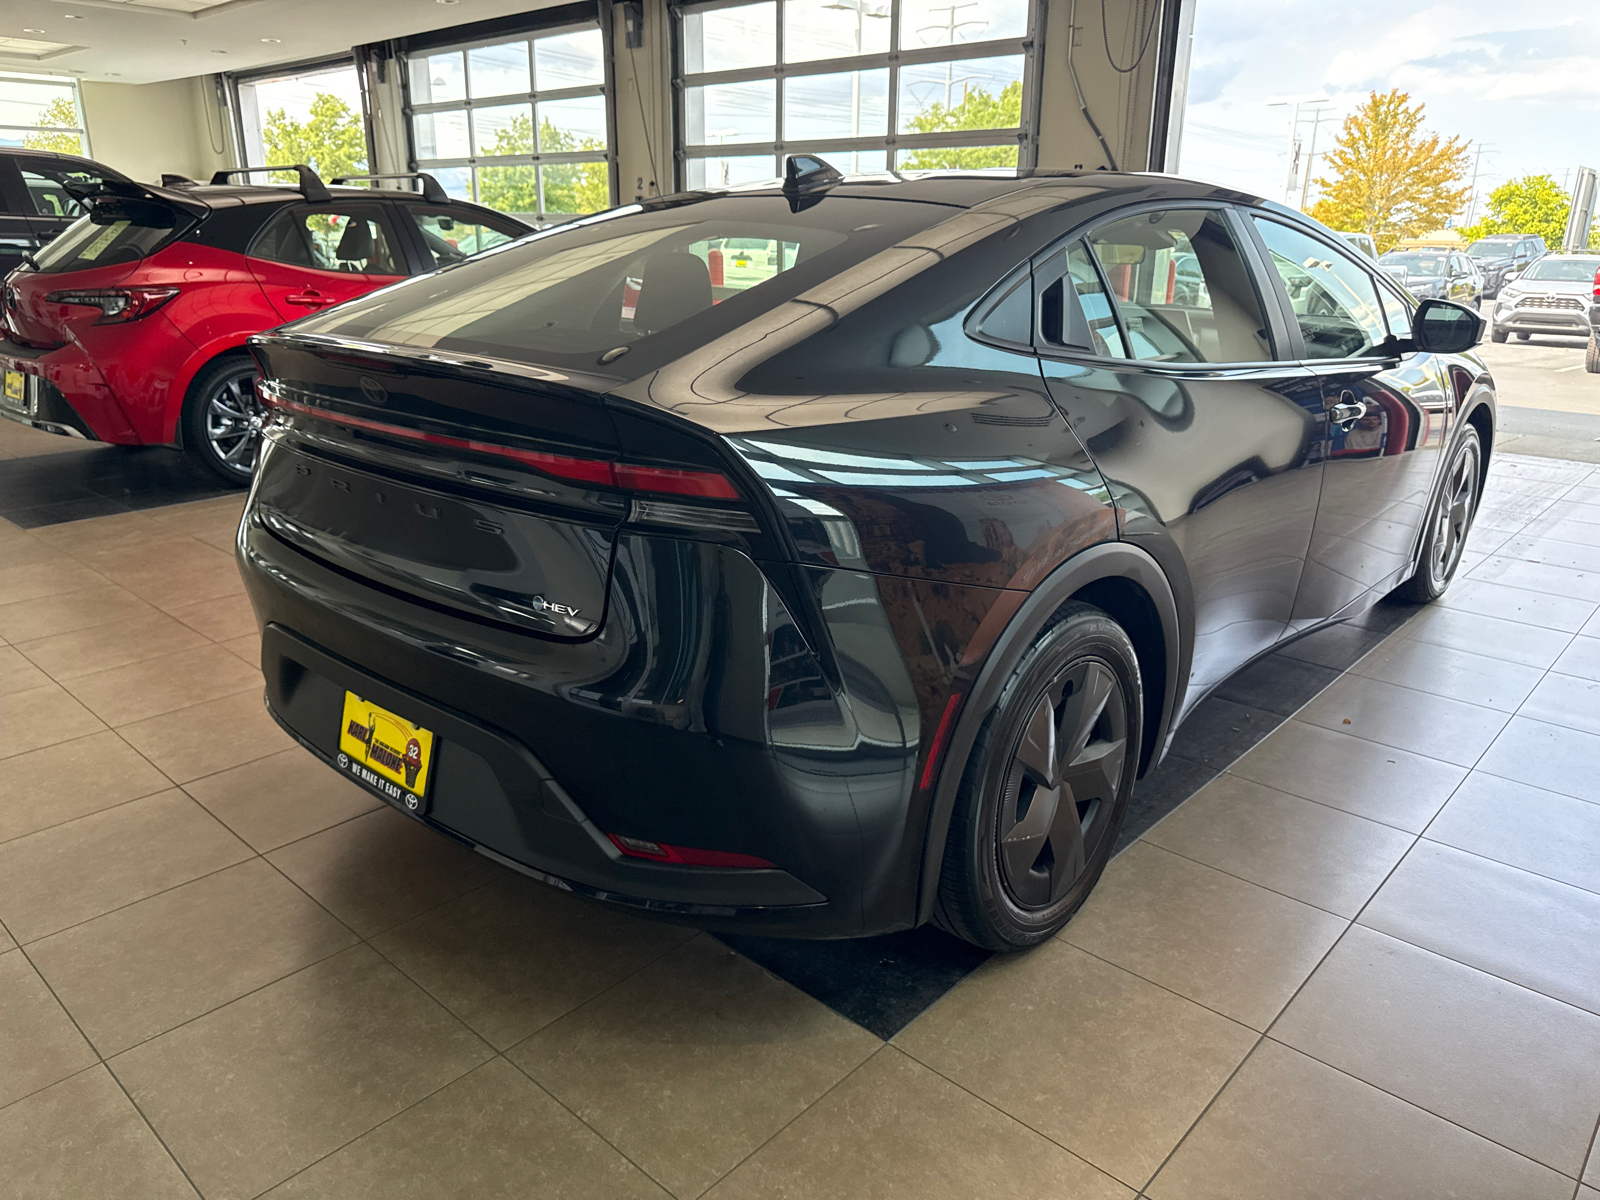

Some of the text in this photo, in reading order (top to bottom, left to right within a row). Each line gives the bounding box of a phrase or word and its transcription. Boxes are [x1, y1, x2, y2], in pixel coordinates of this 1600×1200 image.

[637, 177, 643, 190] 2
[296, 463, 503, 535] PRIUS
[347, 720, 369, 744] KARL
[370, 743, 402, 773] MALONE
[408, 744, 418, 760] 32
[351, 762, 401, 799] WE MAKE IT EASY
